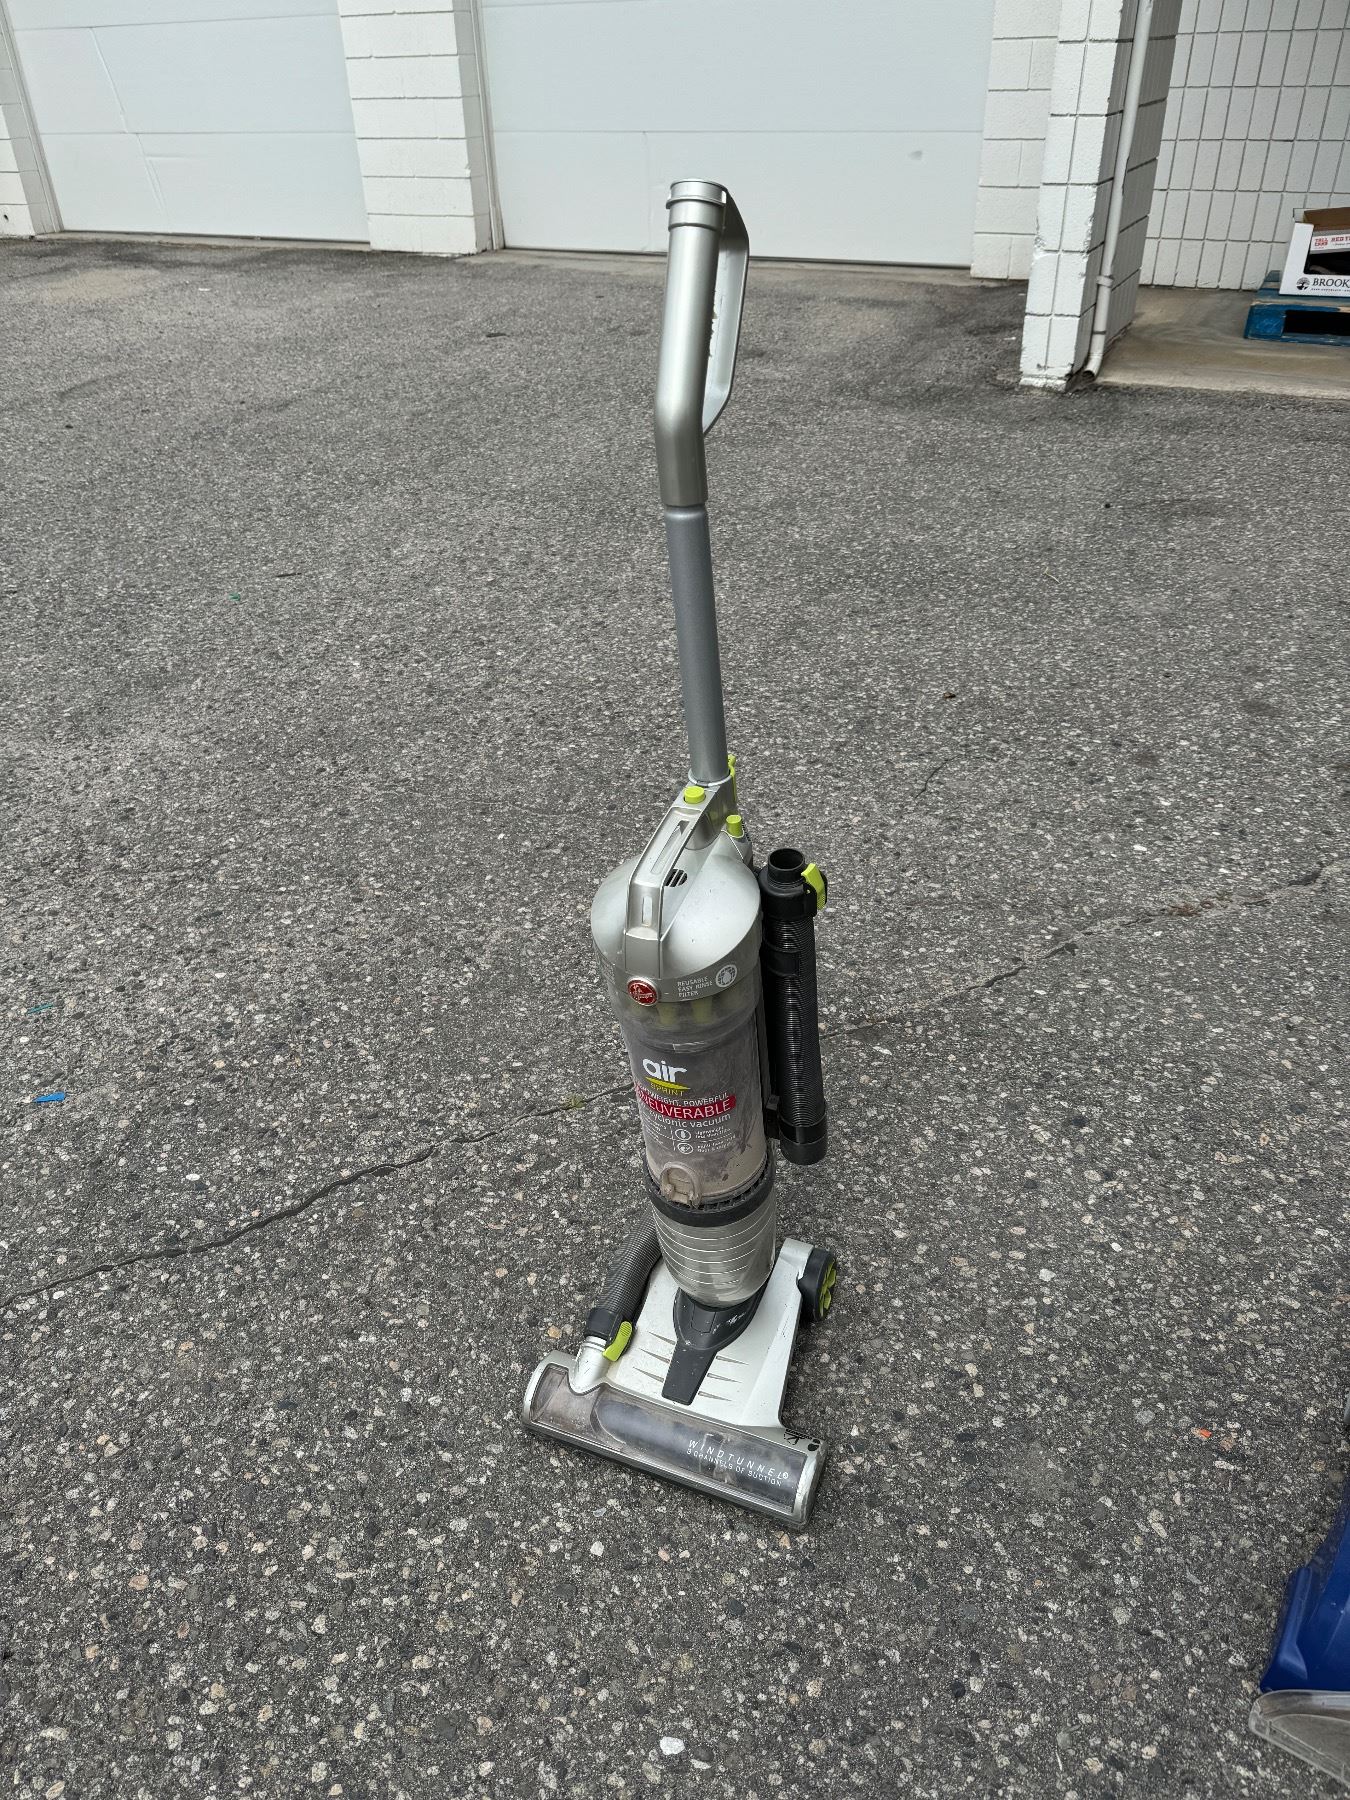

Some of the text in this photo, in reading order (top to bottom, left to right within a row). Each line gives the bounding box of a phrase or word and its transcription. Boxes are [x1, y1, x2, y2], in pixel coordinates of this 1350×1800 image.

[642, 1058, 688, 1083] air
[650, 1082, 685, 1097] SPRINT
[683, 1091, 730, 1107] POWERFUL
[689, 1113, 731, 1128] vacuum
[693, 1450, 733, 1470] CHANNELS
[735, 1465, 746, 1474] OF
[747, 1470, 783, 1487] SUCTION
